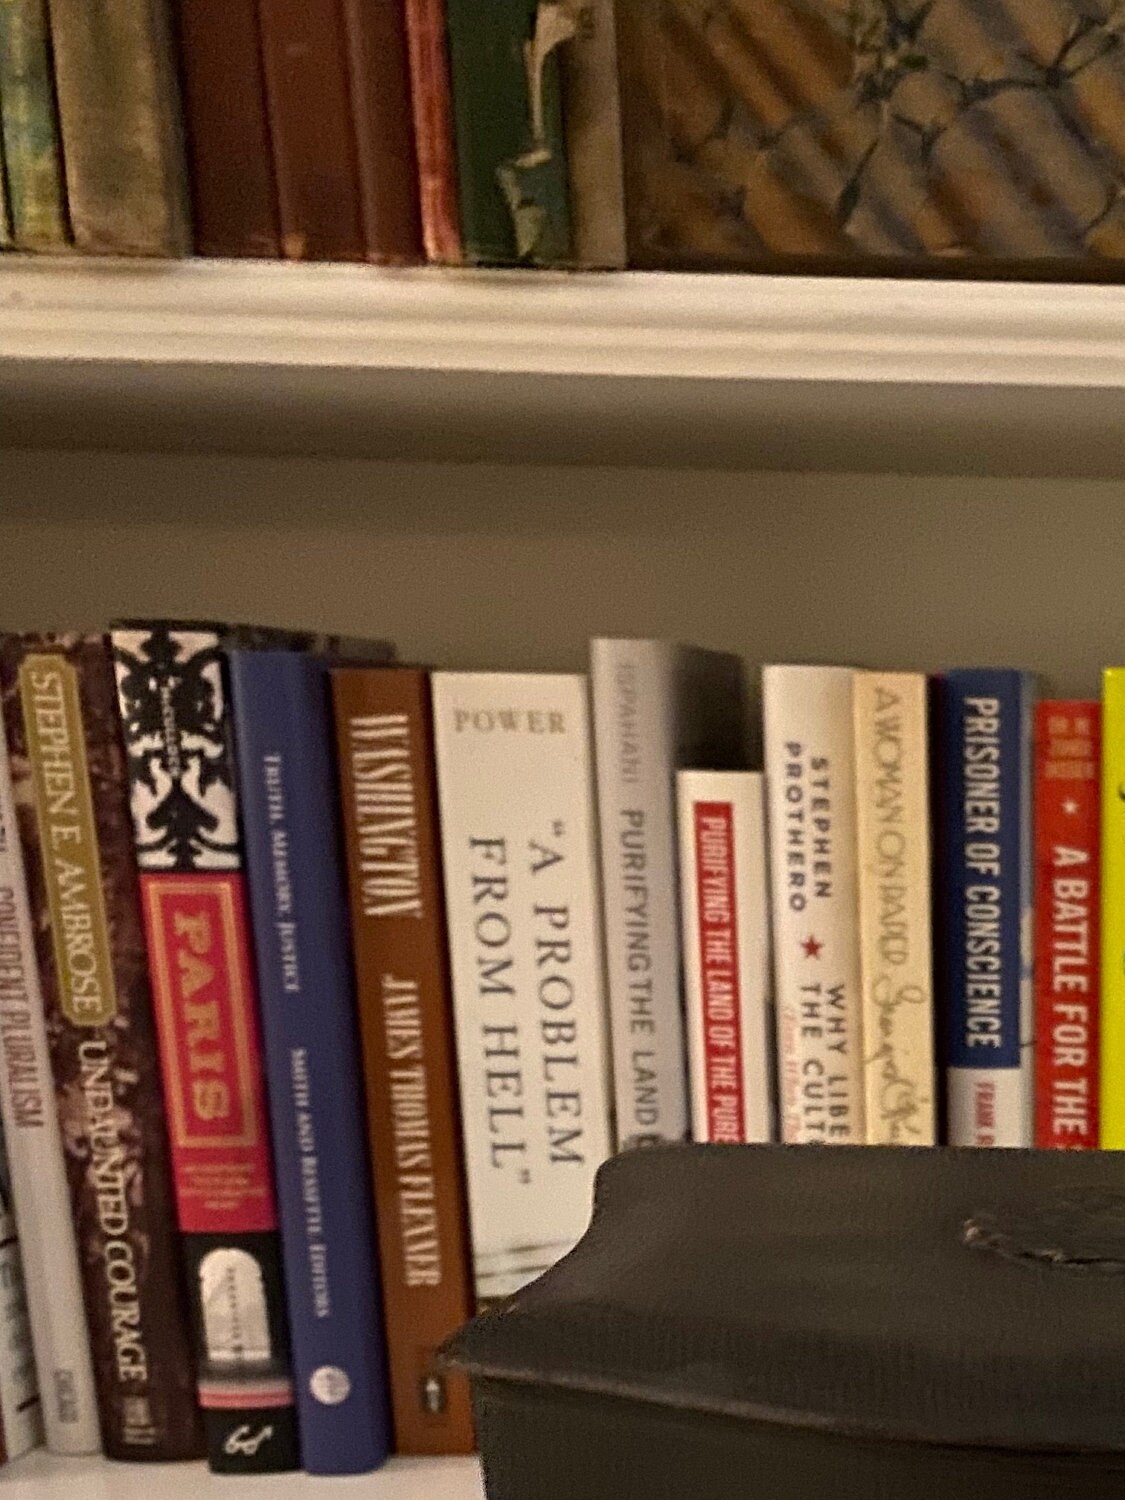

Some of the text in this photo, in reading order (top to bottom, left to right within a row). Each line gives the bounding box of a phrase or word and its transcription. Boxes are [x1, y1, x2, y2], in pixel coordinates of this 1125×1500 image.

[453, 710, 566, 736] POWER
[963, 696, 1001, 834] PRISONER
[29, 671, 103, 1014] STEPHEN E. AMBROSE
[617, 663, 660, 1126] ISPAHANI PURIFYING THE LAND
[784, 741, 806, 913] PROTHERO
[808, 757, 833, 900] STEPHEN
[866, 686, 908, 968] A WOMAN ON PAPER
[965, 842, 1000, 876] OF
[469, 835, 516, 995] FROM
[701, 816, 741, 1143] PURIFYING THE LAND OF THE PURE
[964, 885, 1003, 1049] CONSCIENCE
[1052, 846, 1089, 1133] A BATTLE FOR THE
[6, 1009, 44, 1127] PLURALISM
[173, 910, 230, 1122] PARIS
[349, 712, 443, 1287] WASHINGTON JAMES THOMAS FLEXNER
[533, 904, 585, 1166] PROBLEM
[799, 983, 823, 1038] THE
[826, 983, 850, 1138] WHY LIBE
[78, 1040, 132, 1235] UNDAUNTED
[974, 1081, 997, 1130] FRANK
[104, 1240, 147, 1382] COURAGE
